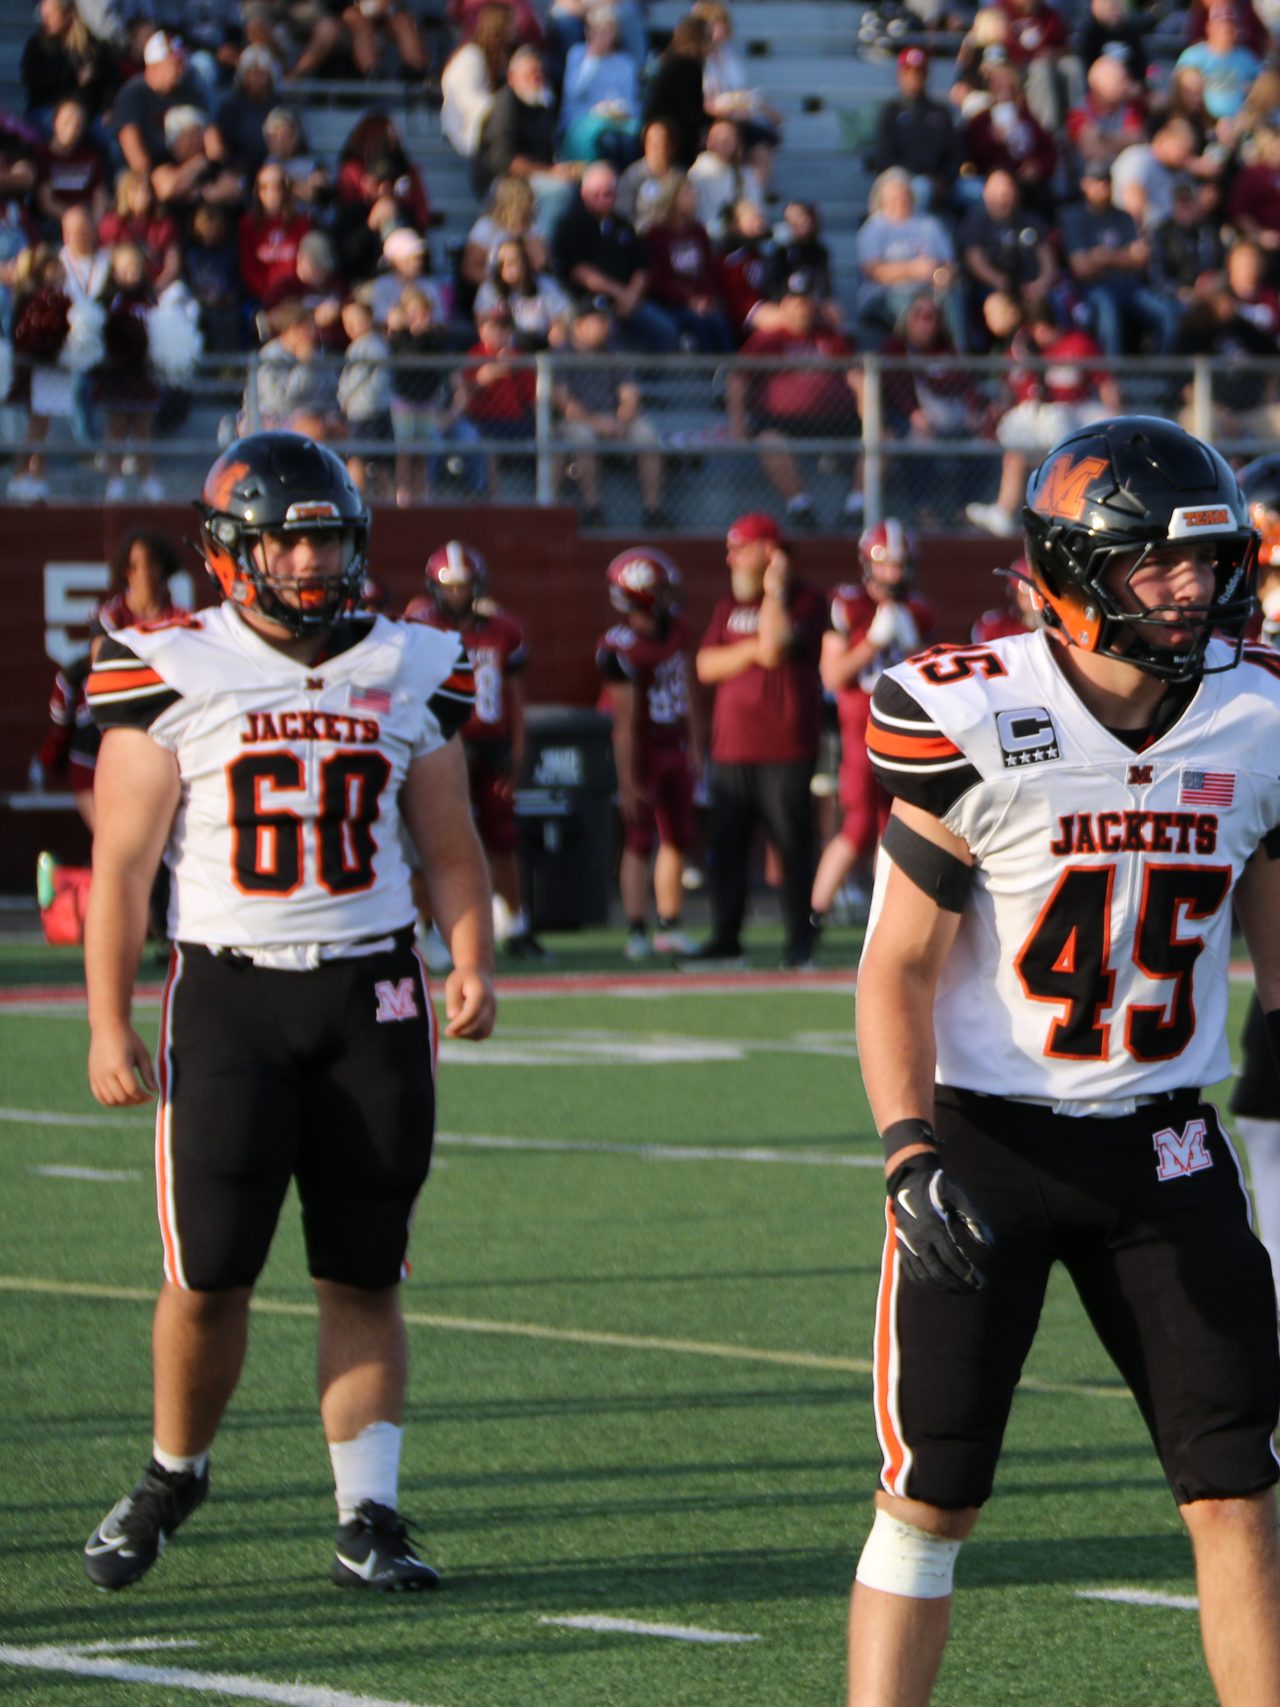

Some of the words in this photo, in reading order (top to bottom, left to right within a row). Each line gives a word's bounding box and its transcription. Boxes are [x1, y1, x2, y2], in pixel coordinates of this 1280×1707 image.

[1034, 453, 1109, 520] M
[1183, 510, 1229, 525] TEAM
[240, 711, 380, 744] JACKETS
[997, 709, 1055, 752] C
[1128, 765, 1153, 784] M
[224, 749, 392, 897] 60
[1050, 811, 1218, 856] JACKETS
[1013, 863, 1232, 1063] 45
[375, 977, 418, 1022] M
[1152, 1118, 1213, 1182] M
